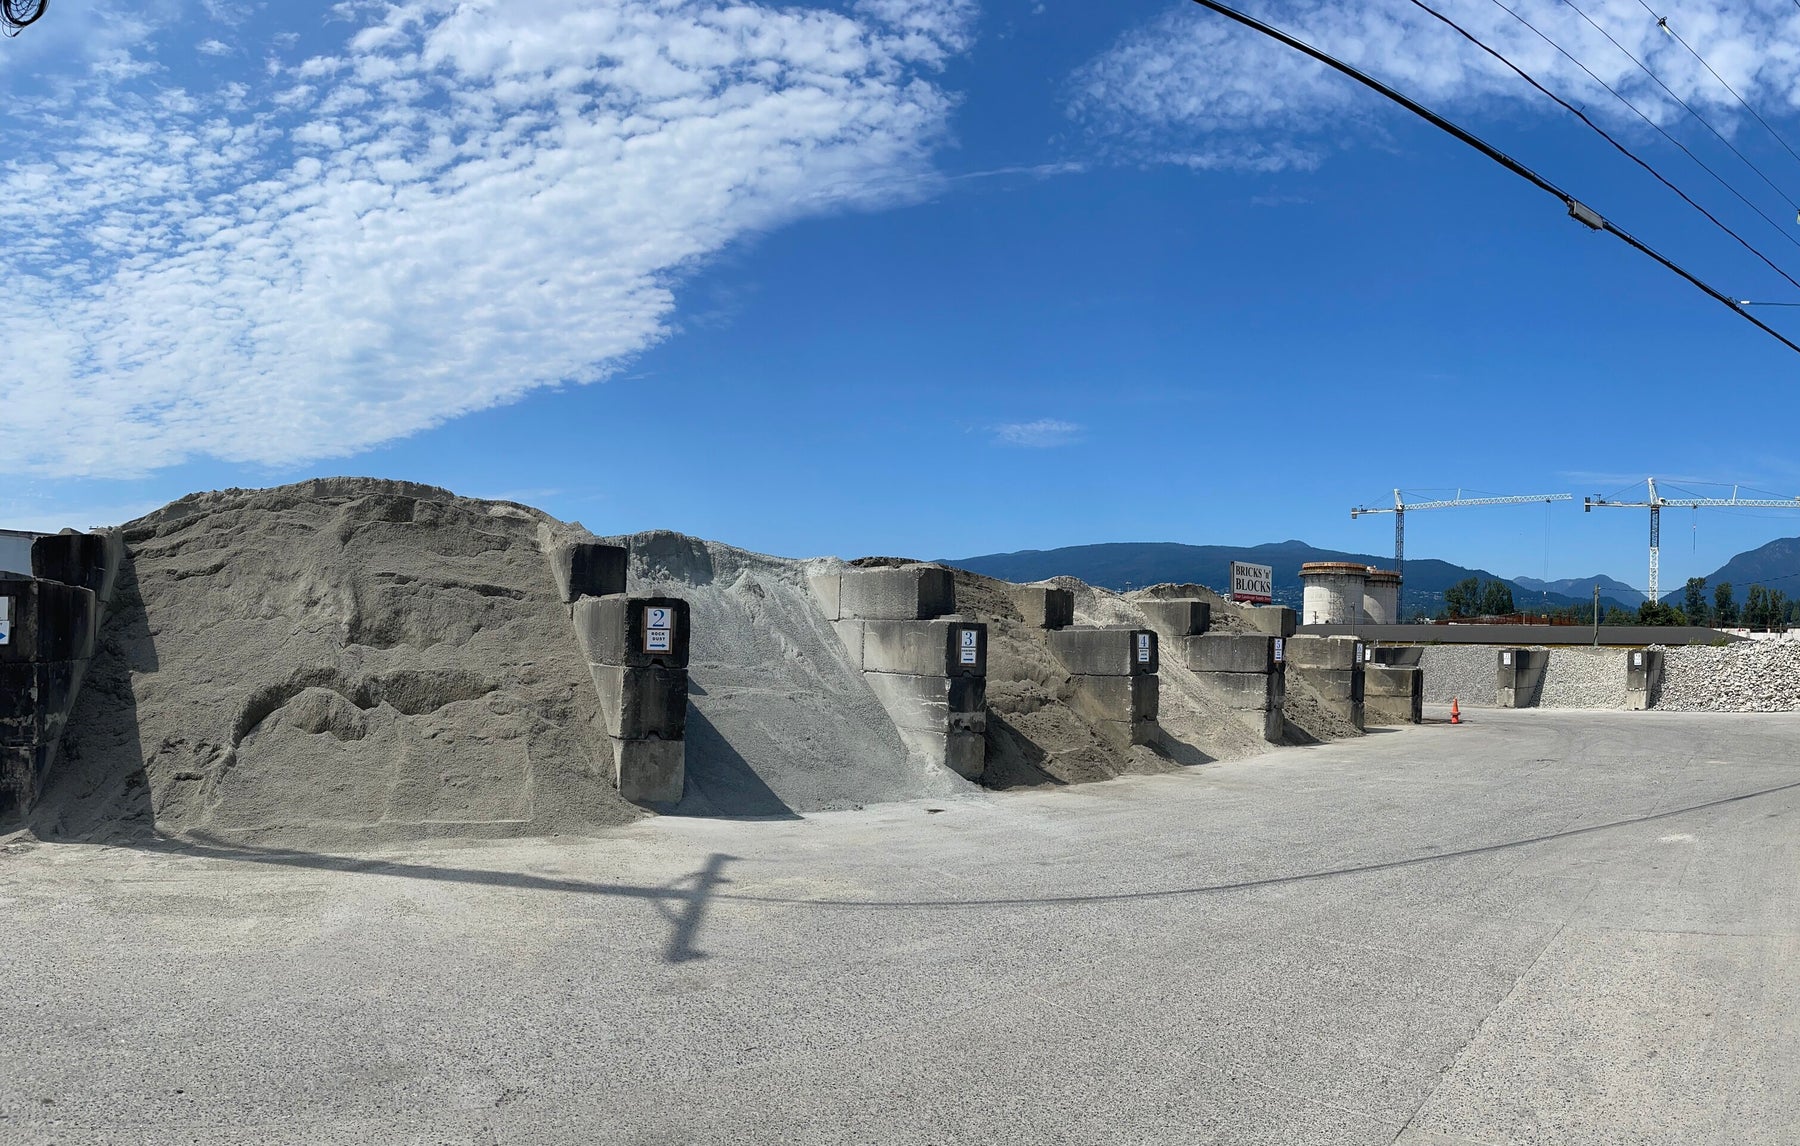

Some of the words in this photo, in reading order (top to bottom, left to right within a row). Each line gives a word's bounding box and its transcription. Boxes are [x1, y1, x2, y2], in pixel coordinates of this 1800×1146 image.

[1235, 565, 1262, 578] BRICKS
[1235, 577, 1271, 593] BLOCKS
[652, 609, 665, 627] 2
[964, 631, 973, 646] 3
[1140, 635, 1148, 647] 4
